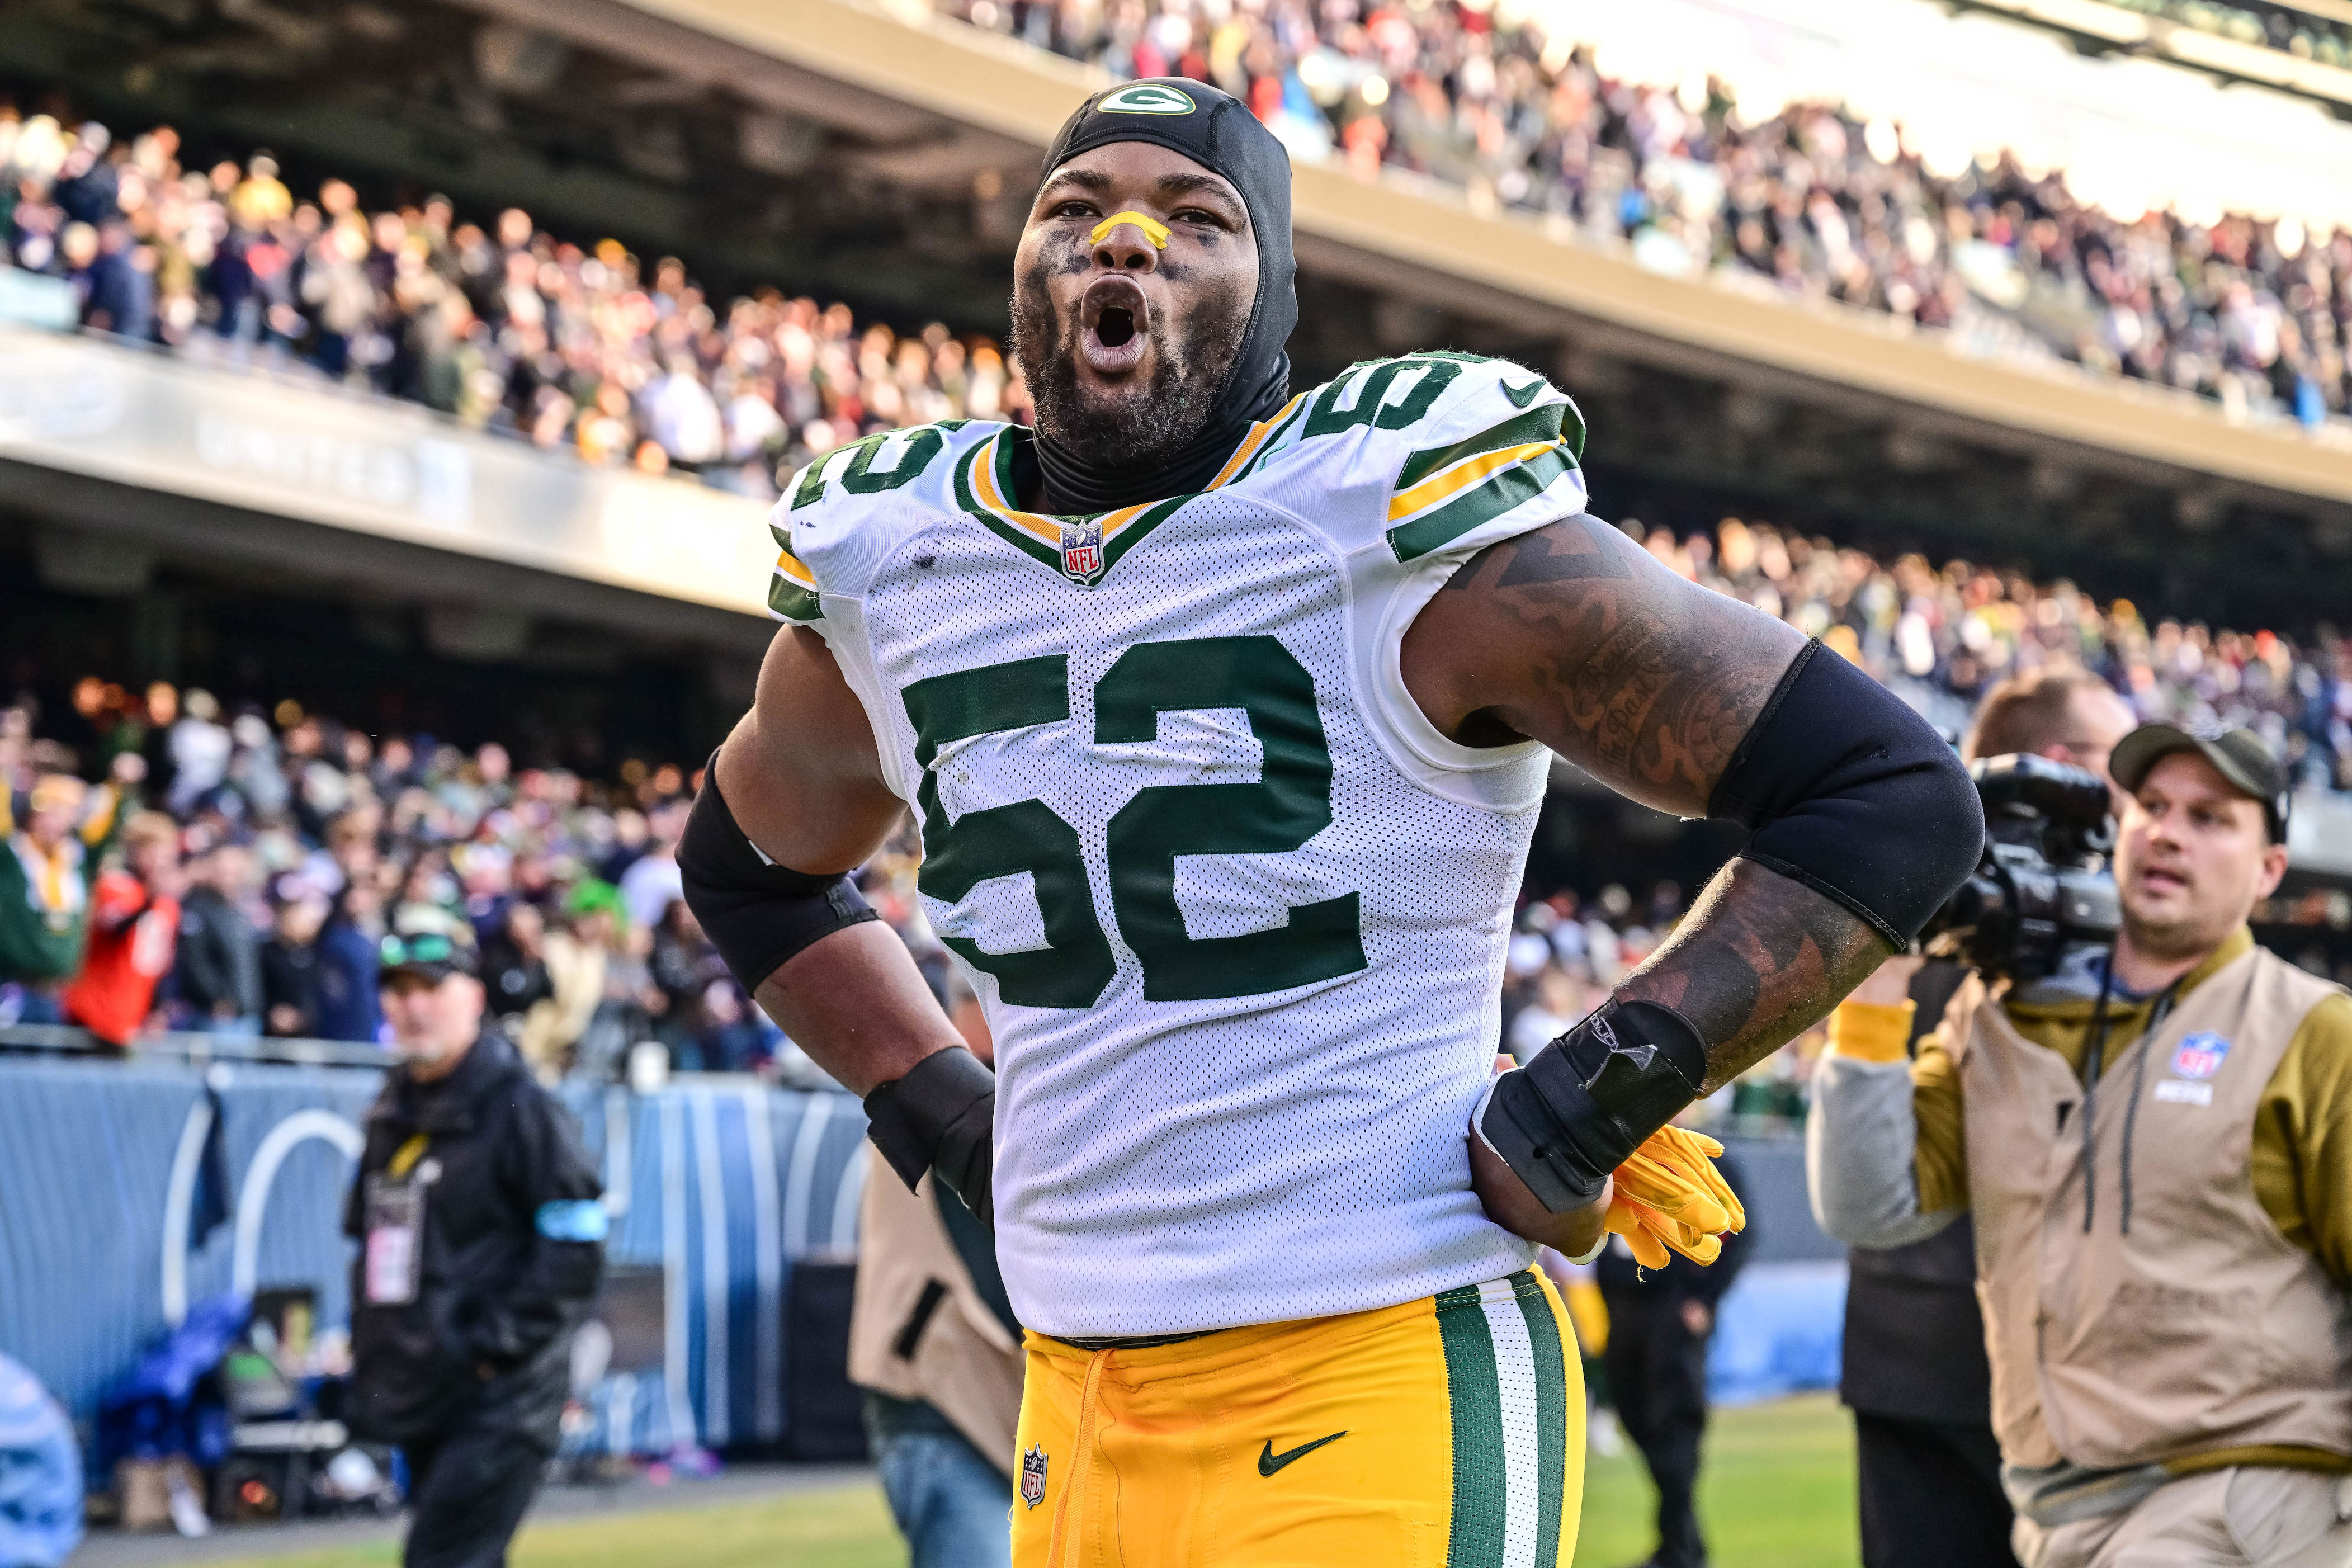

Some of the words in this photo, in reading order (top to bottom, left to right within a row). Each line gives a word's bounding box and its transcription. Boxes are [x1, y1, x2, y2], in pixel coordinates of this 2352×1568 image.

[1300, 350, 1494, 441] 5
[791, 419, 971, 511] 2
[1067, 548, 1098, 573] NFL
[900, 635, 1368, 1008] 52
[1023, 1472, 1040, 1496] NFL
